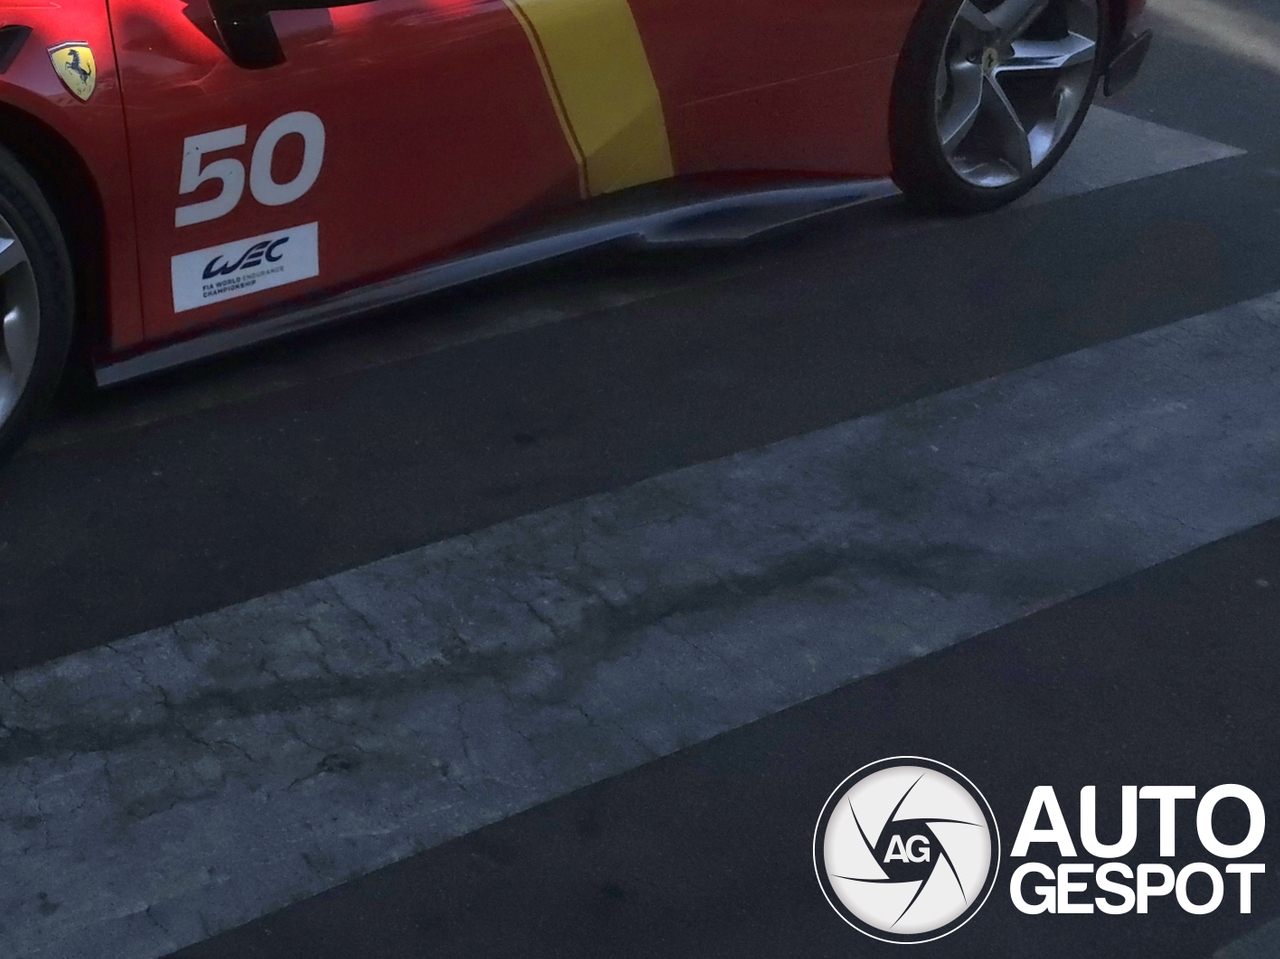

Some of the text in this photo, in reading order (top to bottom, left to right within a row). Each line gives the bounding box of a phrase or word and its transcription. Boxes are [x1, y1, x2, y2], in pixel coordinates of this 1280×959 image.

[175, 110, 326, 228] 50
[202, 236, 290, 280] WEC
[202, 266, 284, 291] FIA WORLD ENDURANCE
[203, 279, 257, 298] CHAMPIONSHIP
